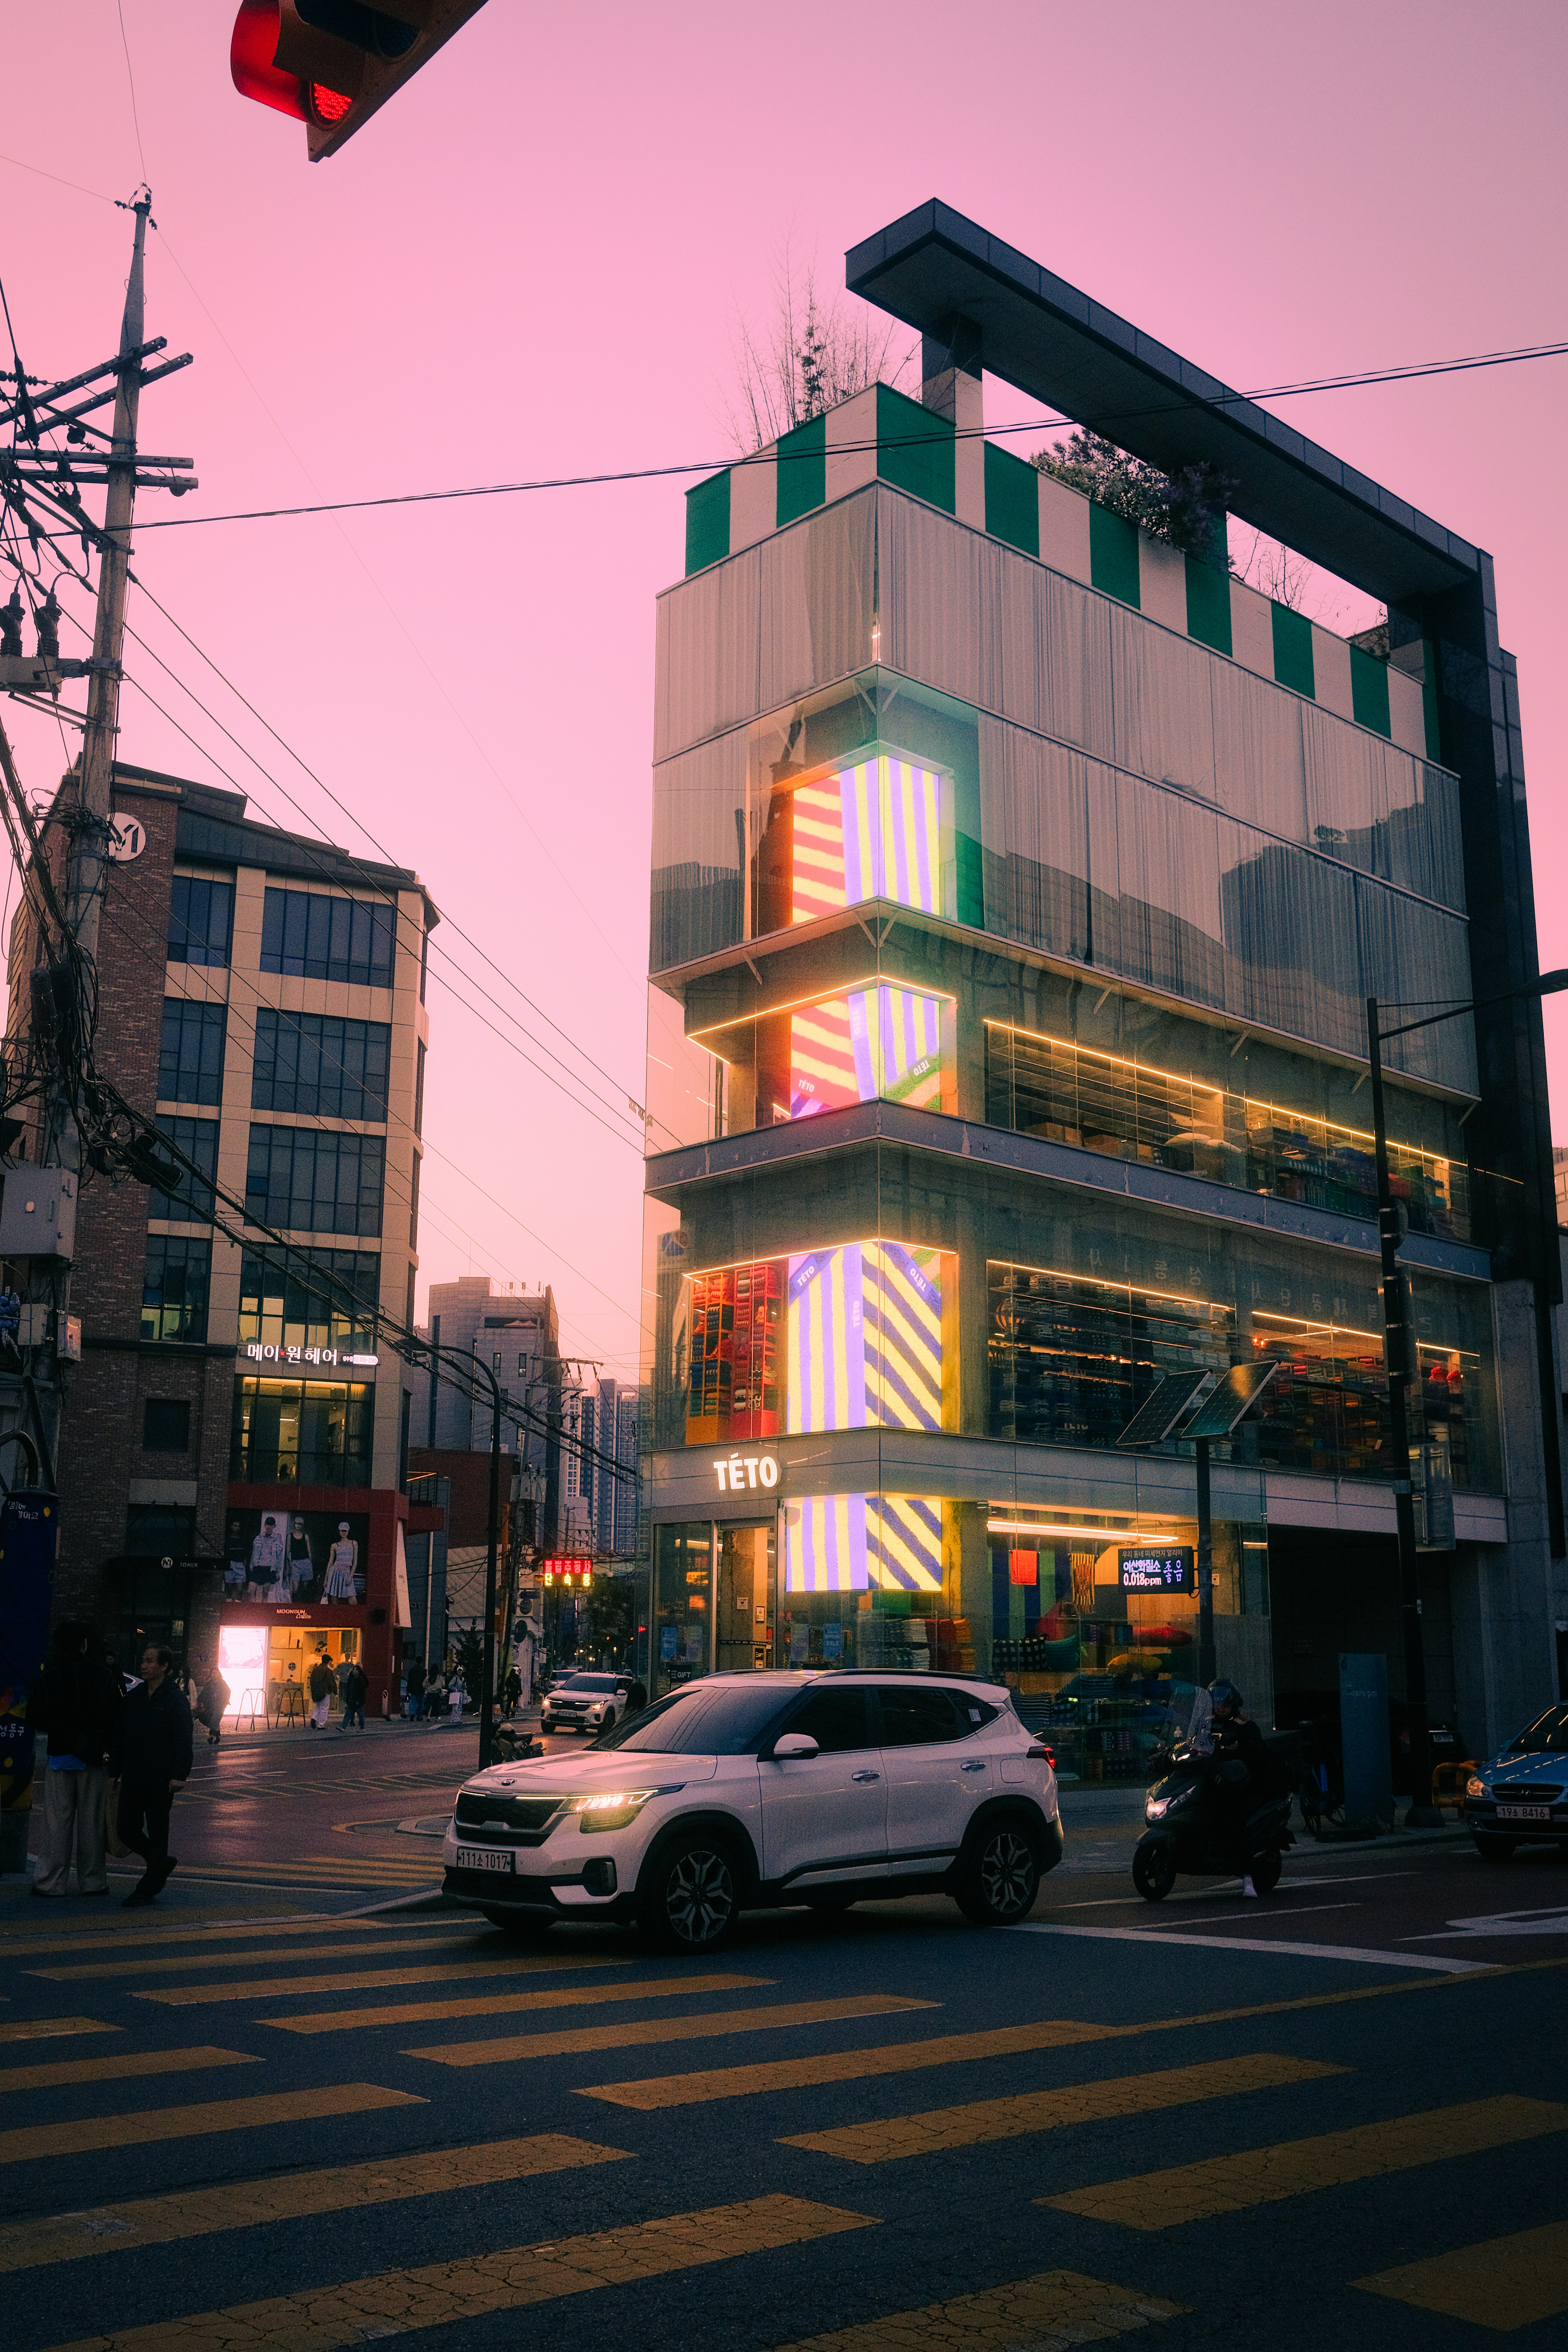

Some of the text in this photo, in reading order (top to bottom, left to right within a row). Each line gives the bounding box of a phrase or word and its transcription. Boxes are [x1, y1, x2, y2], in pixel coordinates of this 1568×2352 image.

[913, 1060, 930, 1076] TÉTO
[798, 1079, 815, 1093] TÉTO
[797, 1265, 815, 1286] TÉTO
[910, 1267, 927, 1292] TÉTO
[852, 1300, 861, 1328] TÉTO
[714, 1452, 779, 1491] TÉTO
[1123, 1559, 1161, 1573] 이산화질소
[1163, 1559, 1183, 1583] 좋음
[1123, 1573, 1162, 1586] 0.018ppm
[1522, 1808, 1546, 1818] 8416
[485, 1853, 507, 1870] 1017
